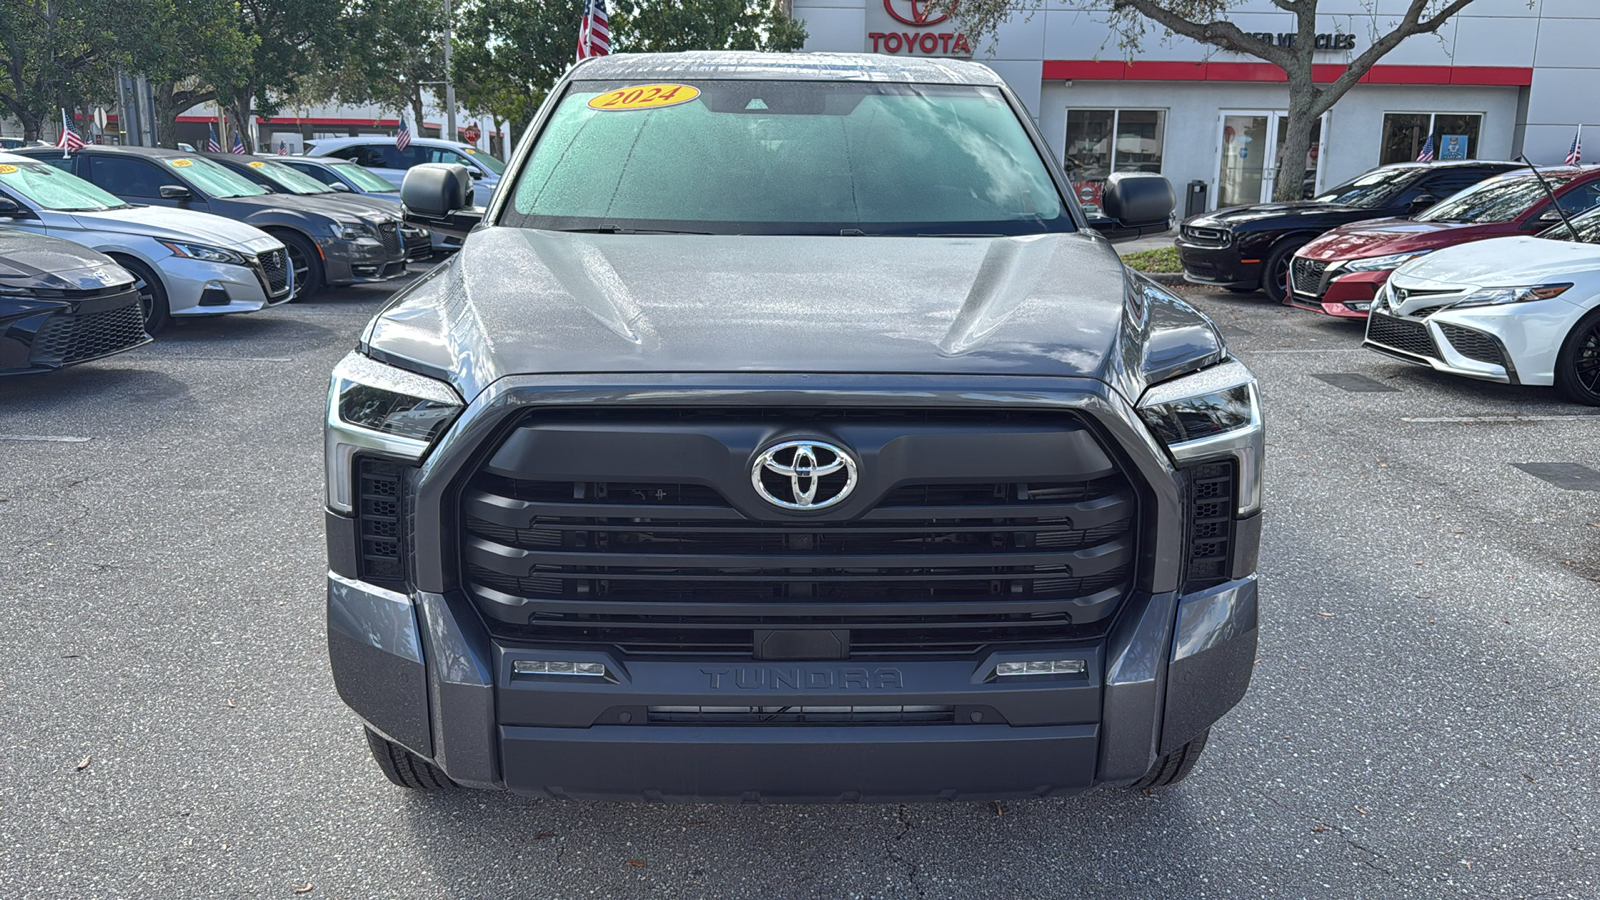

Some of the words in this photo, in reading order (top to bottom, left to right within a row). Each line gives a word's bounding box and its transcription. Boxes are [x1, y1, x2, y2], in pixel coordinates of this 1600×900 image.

[868, 32, 971, 53] TOYOTA
[601, 85, 682, 107] 2024
[700, 667, 904, 689] TUNDRA
